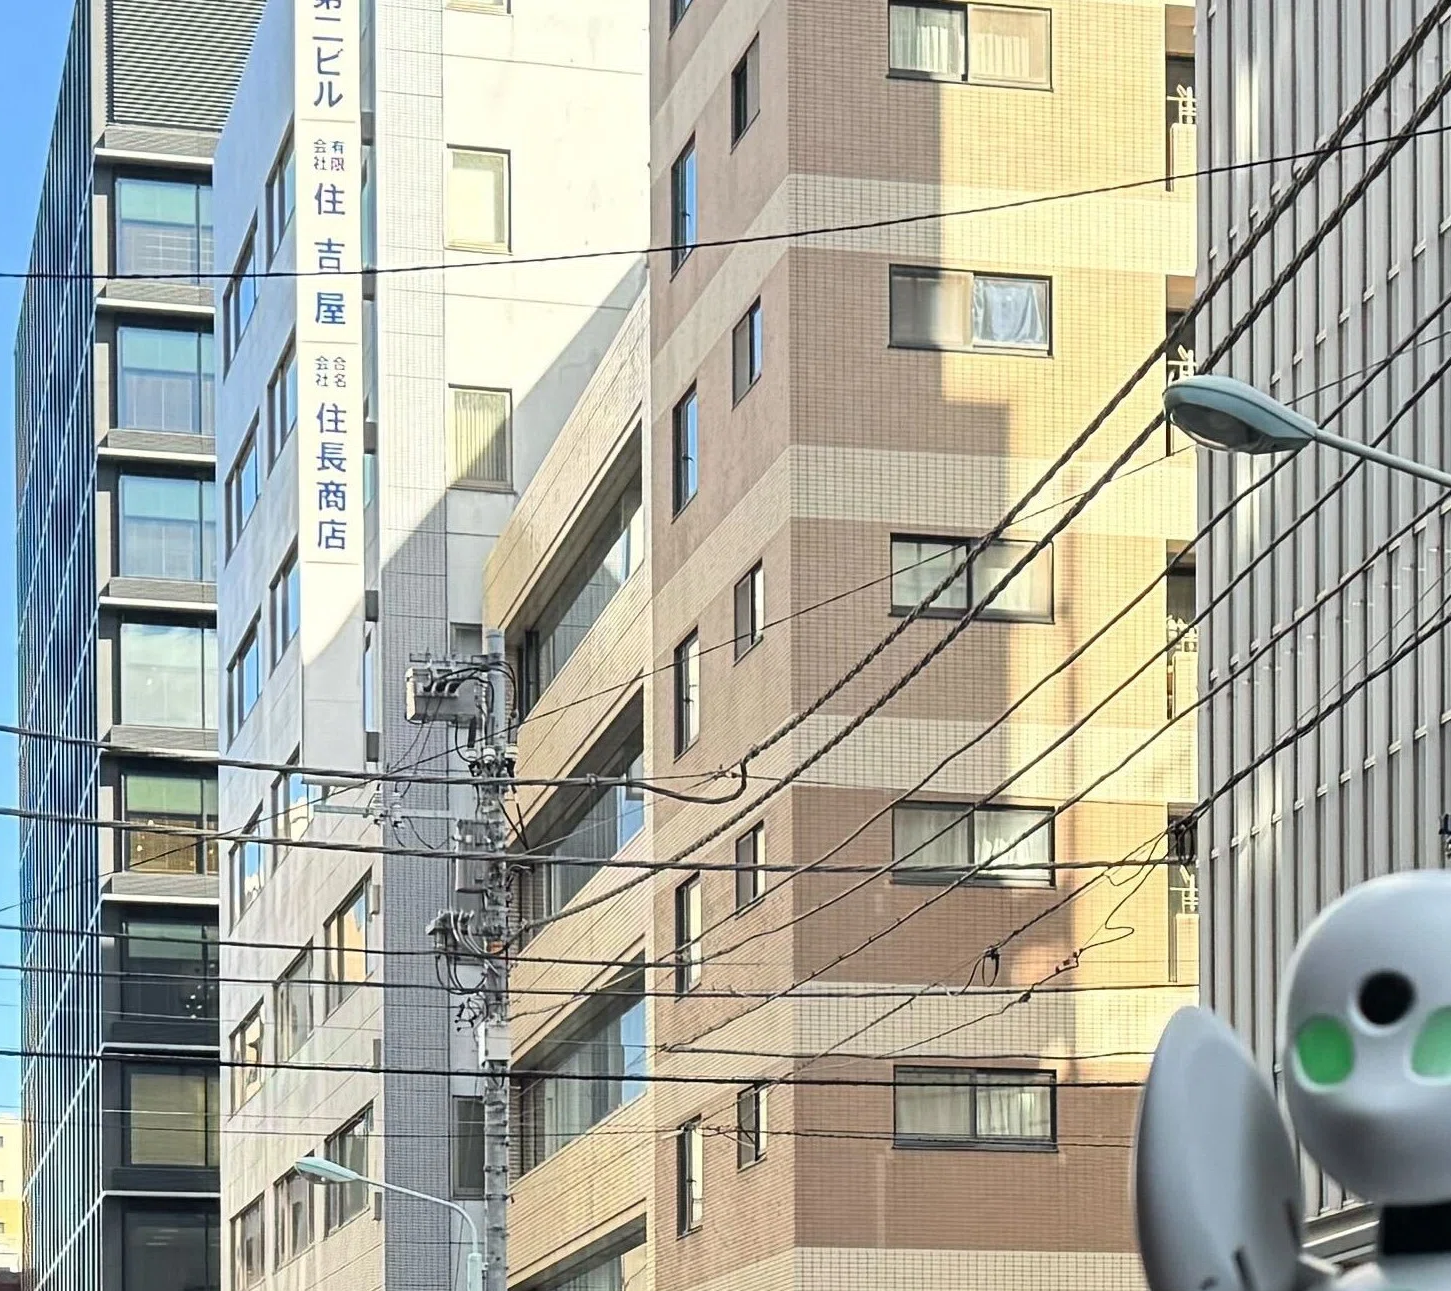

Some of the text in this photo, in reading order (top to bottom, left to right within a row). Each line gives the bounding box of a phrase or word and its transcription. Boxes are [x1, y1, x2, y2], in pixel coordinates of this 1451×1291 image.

[313, 182, 346, 325] 住吉屋
[315, 402, 347, 550] 住長商店
